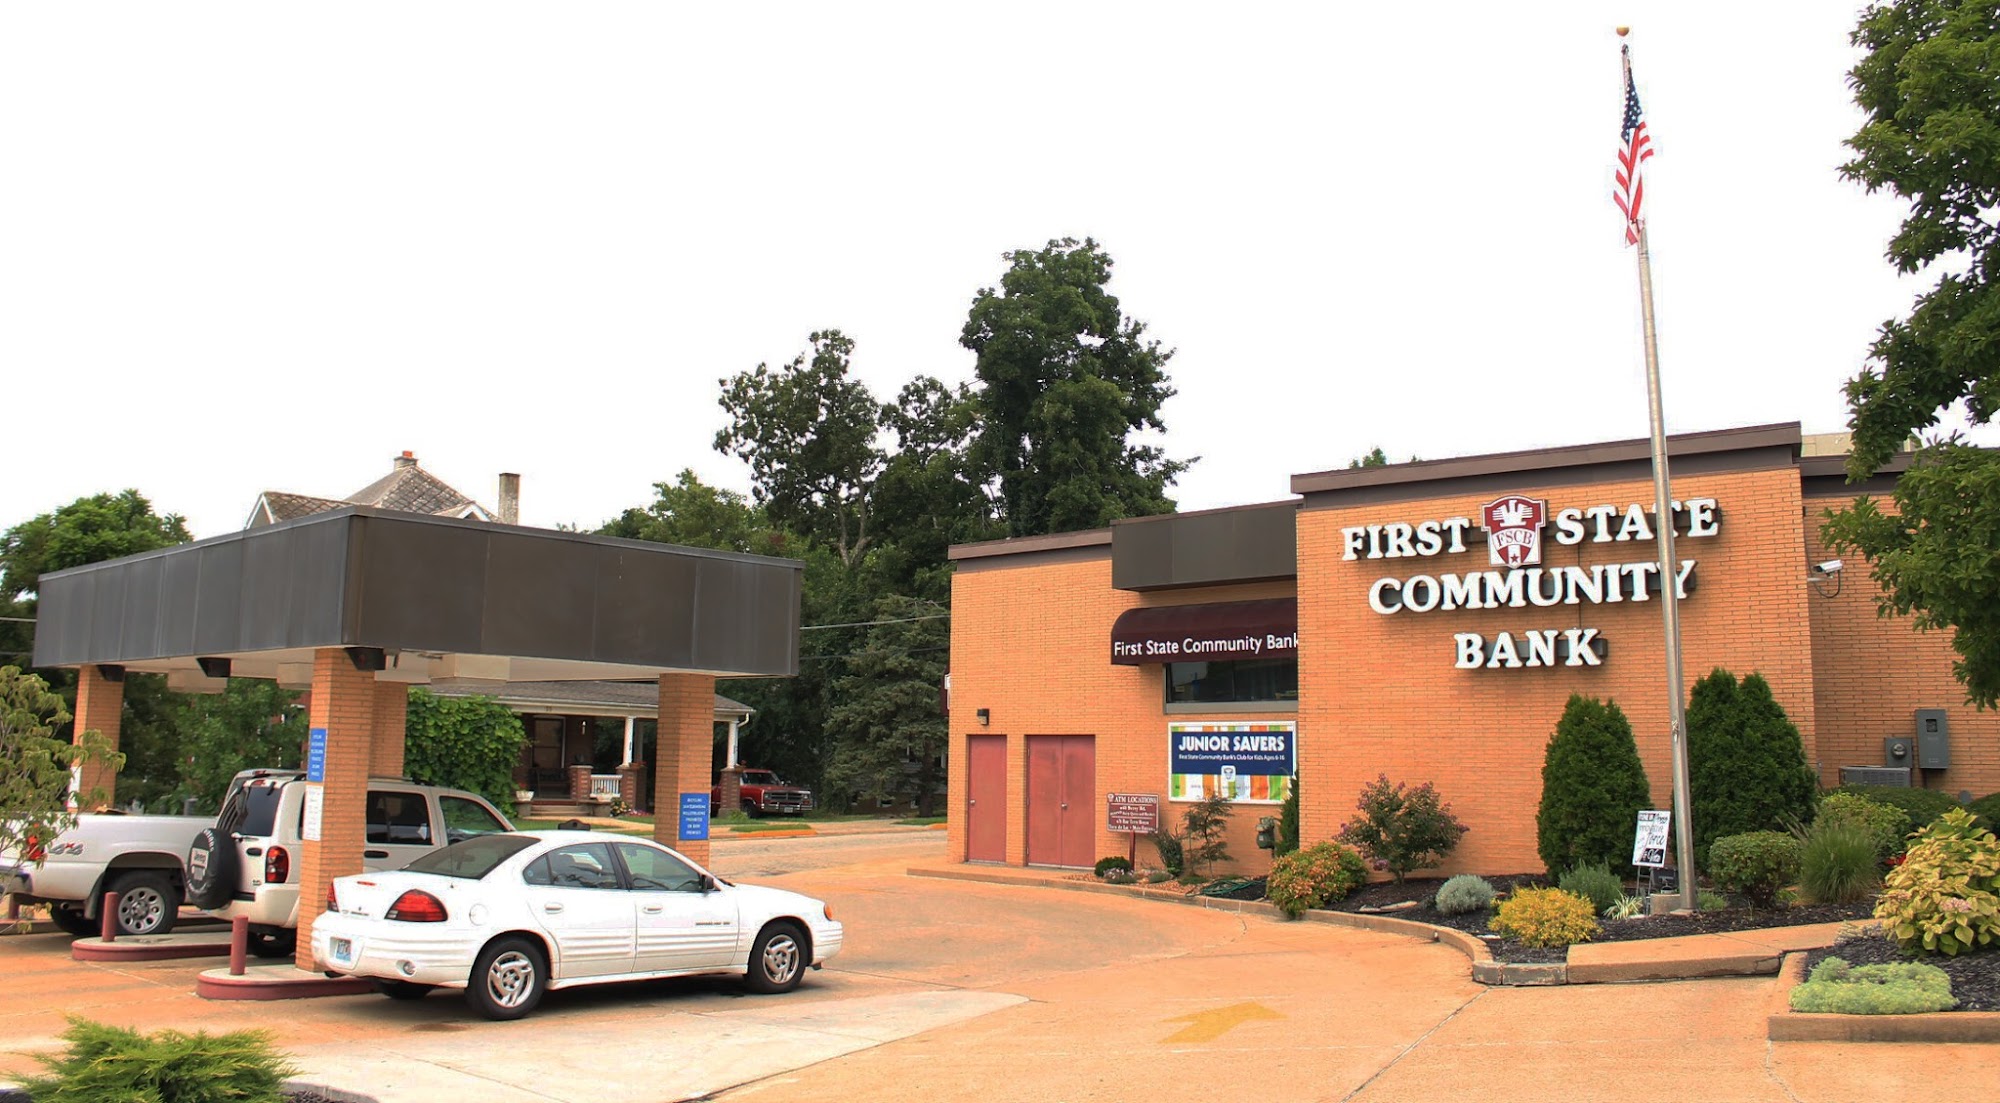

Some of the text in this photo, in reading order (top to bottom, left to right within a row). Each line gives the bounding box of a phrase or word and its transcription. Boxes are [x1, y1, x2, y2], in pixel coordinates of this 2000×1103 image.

[1341, 517, 1470, 561] FIRST
[1496, 530, 1533, 547] FSCB
[1368, 560, 1697, 614] COMMUNITY
[1114, 632, 1299, 656] First State Community Bank
[1454, 628, 1602, 669] BANK
[1178, 736, 1285, 751] JUNIOR SAVERS
